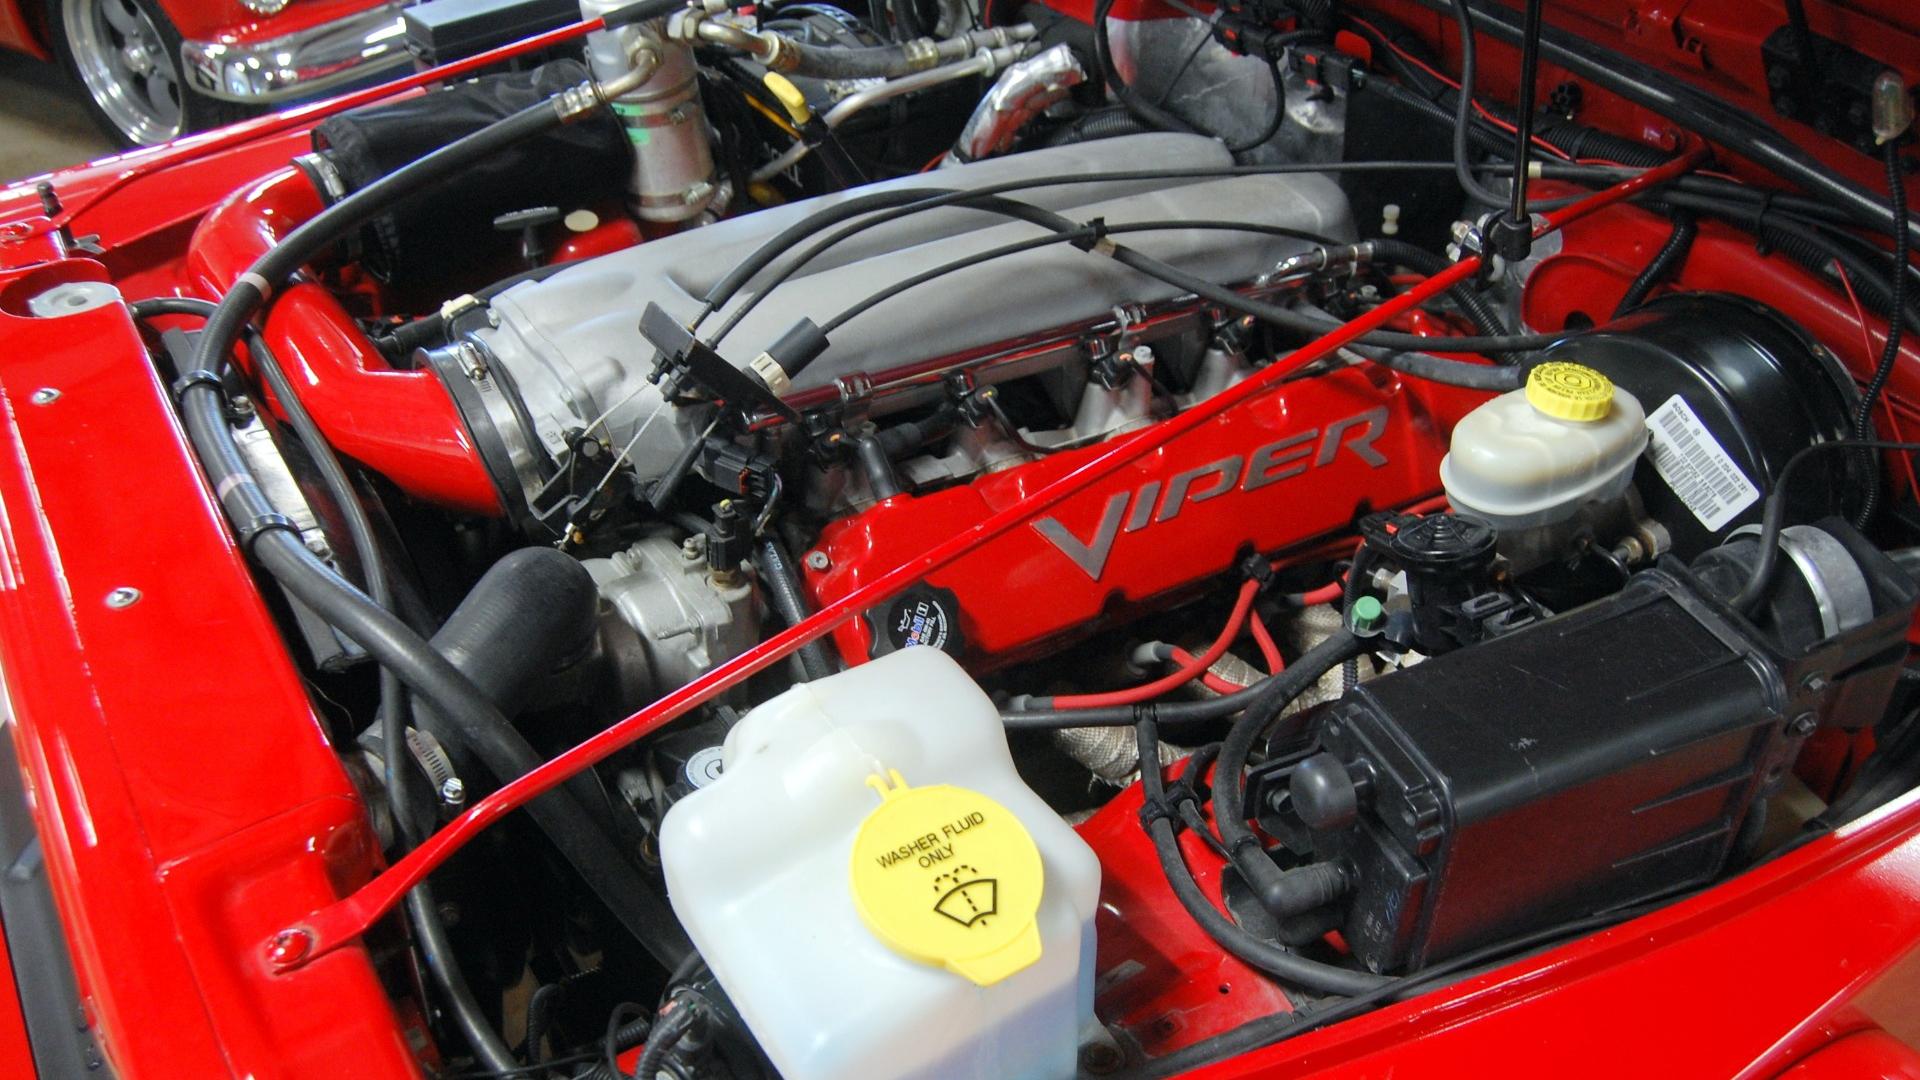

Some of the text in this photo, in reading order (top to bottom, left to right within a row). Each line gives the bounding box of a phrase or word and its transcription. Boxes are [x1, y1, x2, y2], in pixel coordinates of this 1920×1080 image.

[1672, 402, 1689, 423] BOSCH
[1030, 405, 1389, 580] VIPER
[876, 811, 984, 868] WASHER FLUID
[918, 844, 954, 868] ONLY
